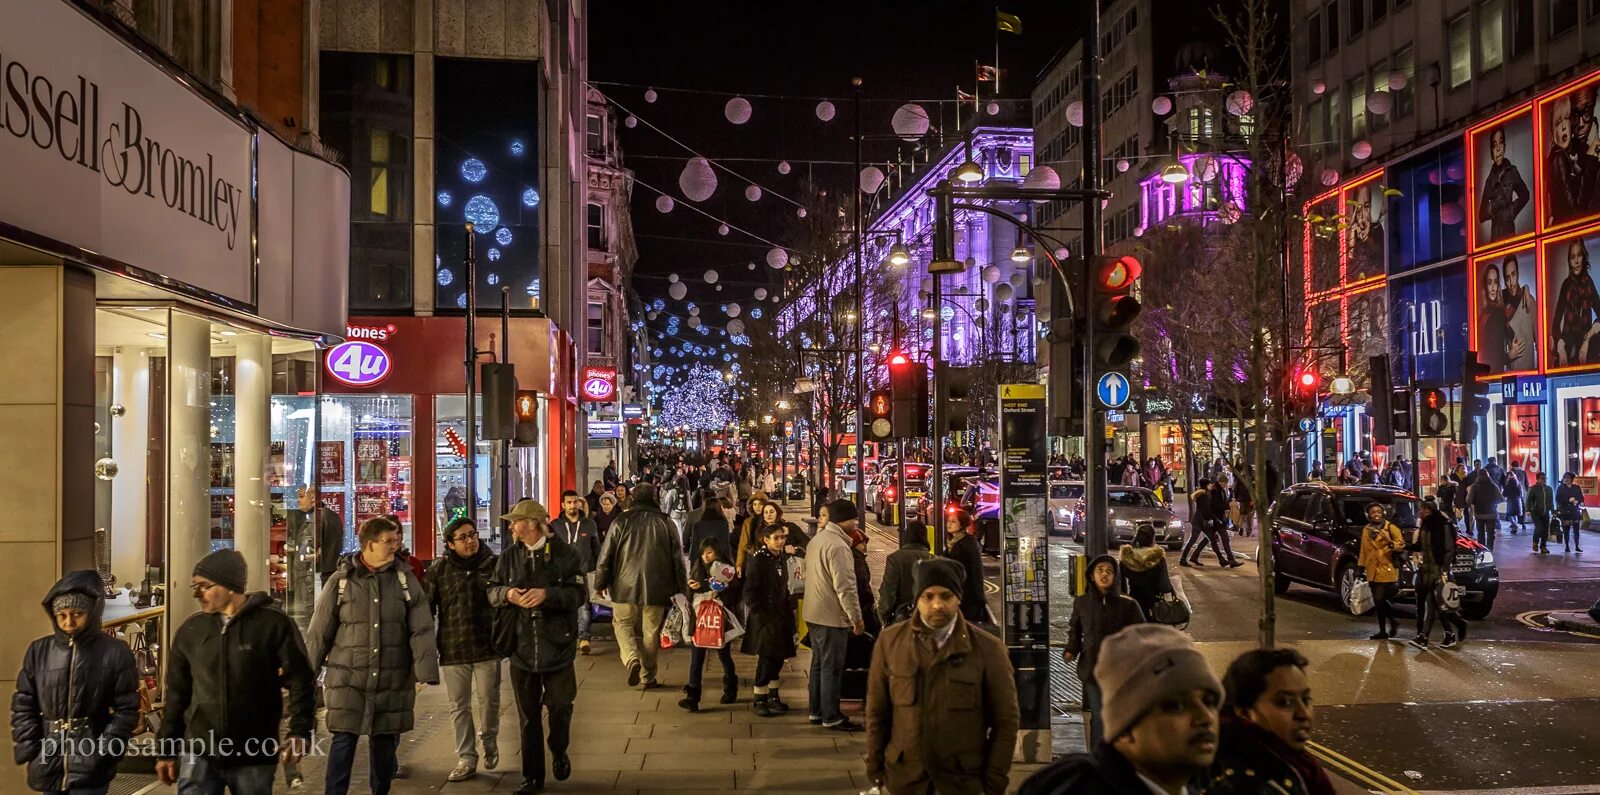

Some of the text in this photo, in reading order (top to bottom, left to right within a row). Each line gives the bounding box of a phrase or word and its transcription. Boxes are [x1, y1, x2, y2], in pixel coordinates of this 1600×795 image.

[0, 54, 101, 173] ssell
[121, 101, 242, 250] Bromley
[587, 370, 611, 379] phones
[587, 380, 608, 395] 4u
[1503, 382, 1542, 398] GAP GAP
[1519, 447, 1540, 473] 75
[697, 614, 720, 629] ALE
